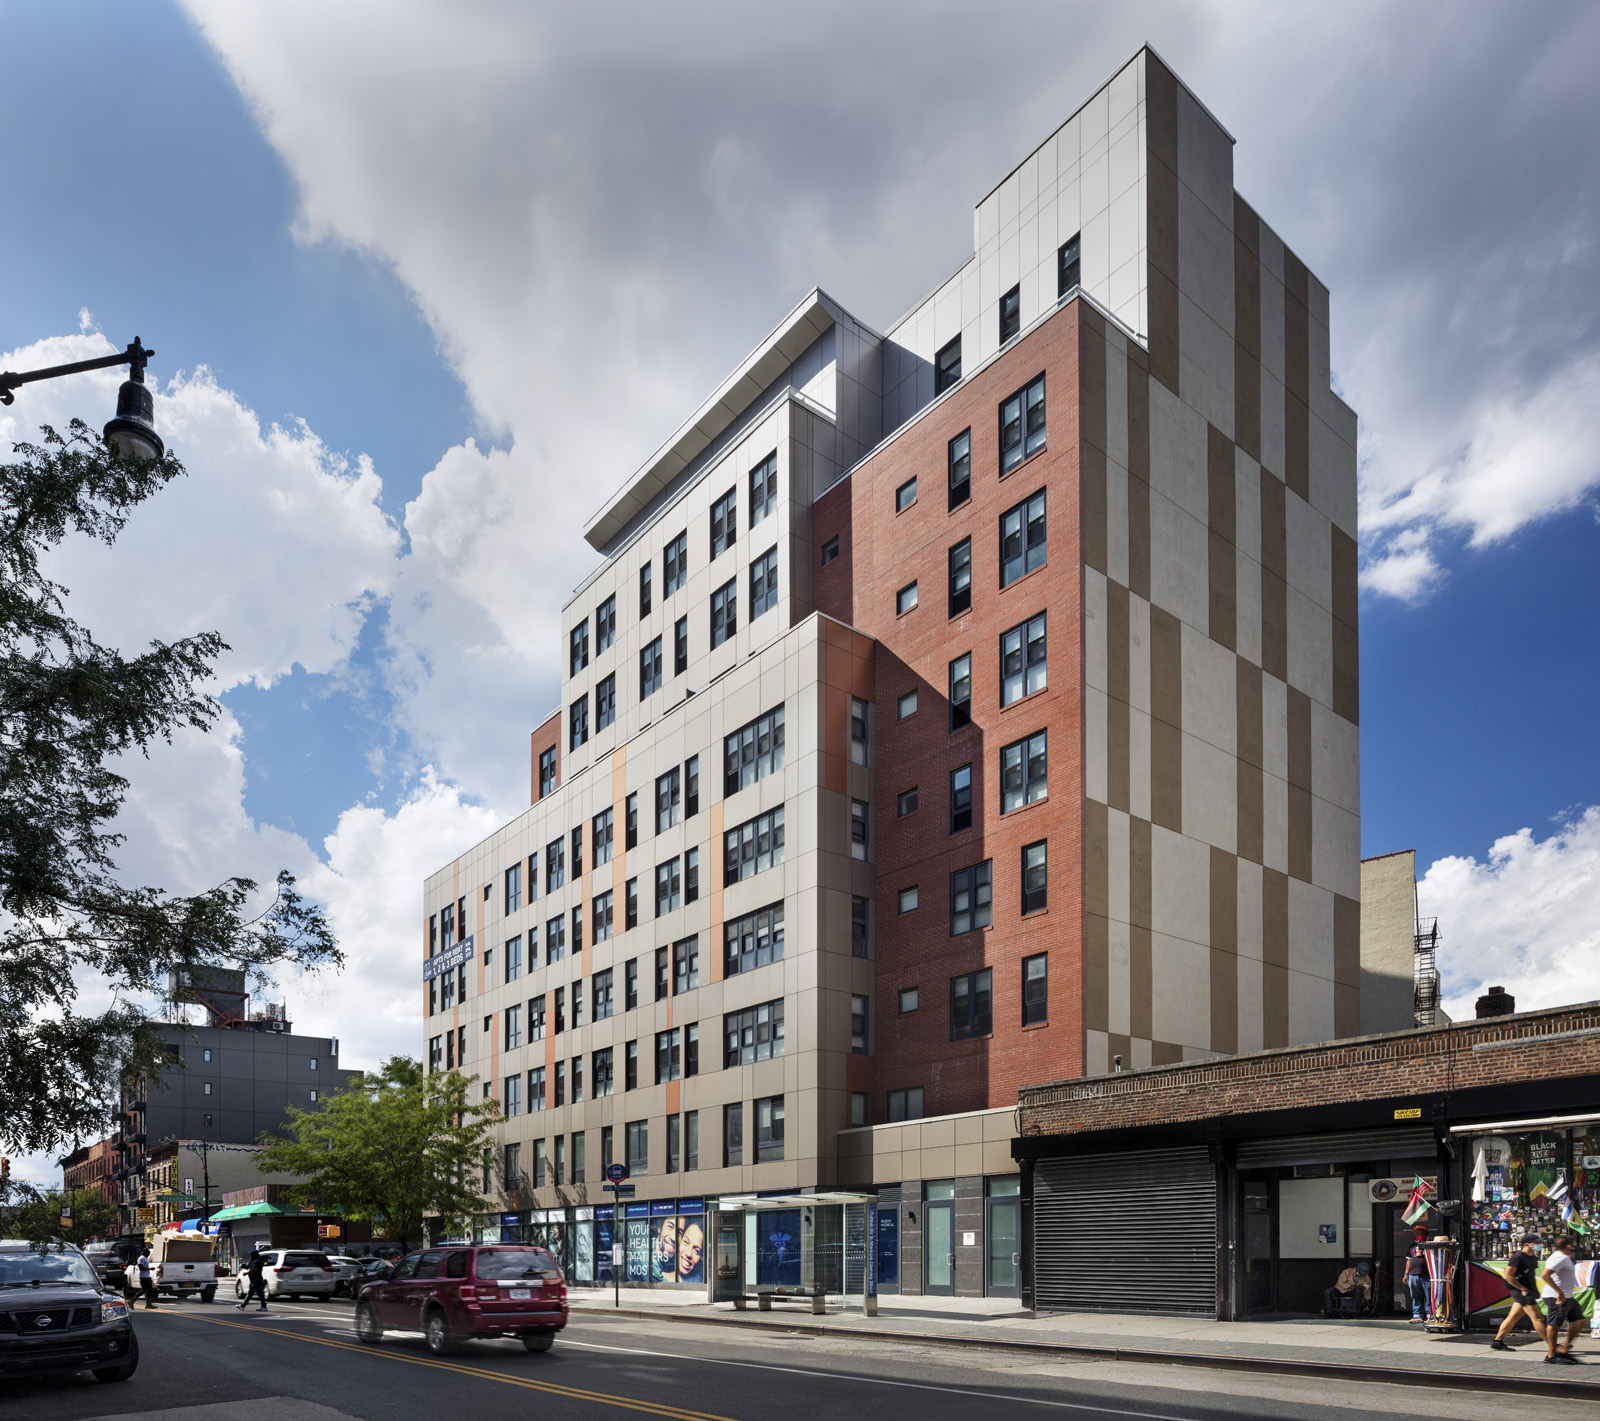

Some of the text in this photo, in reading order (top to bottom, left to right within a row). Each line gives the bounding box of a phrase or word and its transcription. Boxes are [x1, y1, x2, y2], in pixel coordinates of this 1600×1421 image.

[433, 955, 444, 966] APTS
[444, 951, 452, 960] FOR
[452, 944, 463, 956] RENT
[450, 953, 463, 966] BEDS
[1530, 1142, 1556, 1151] BLACK
